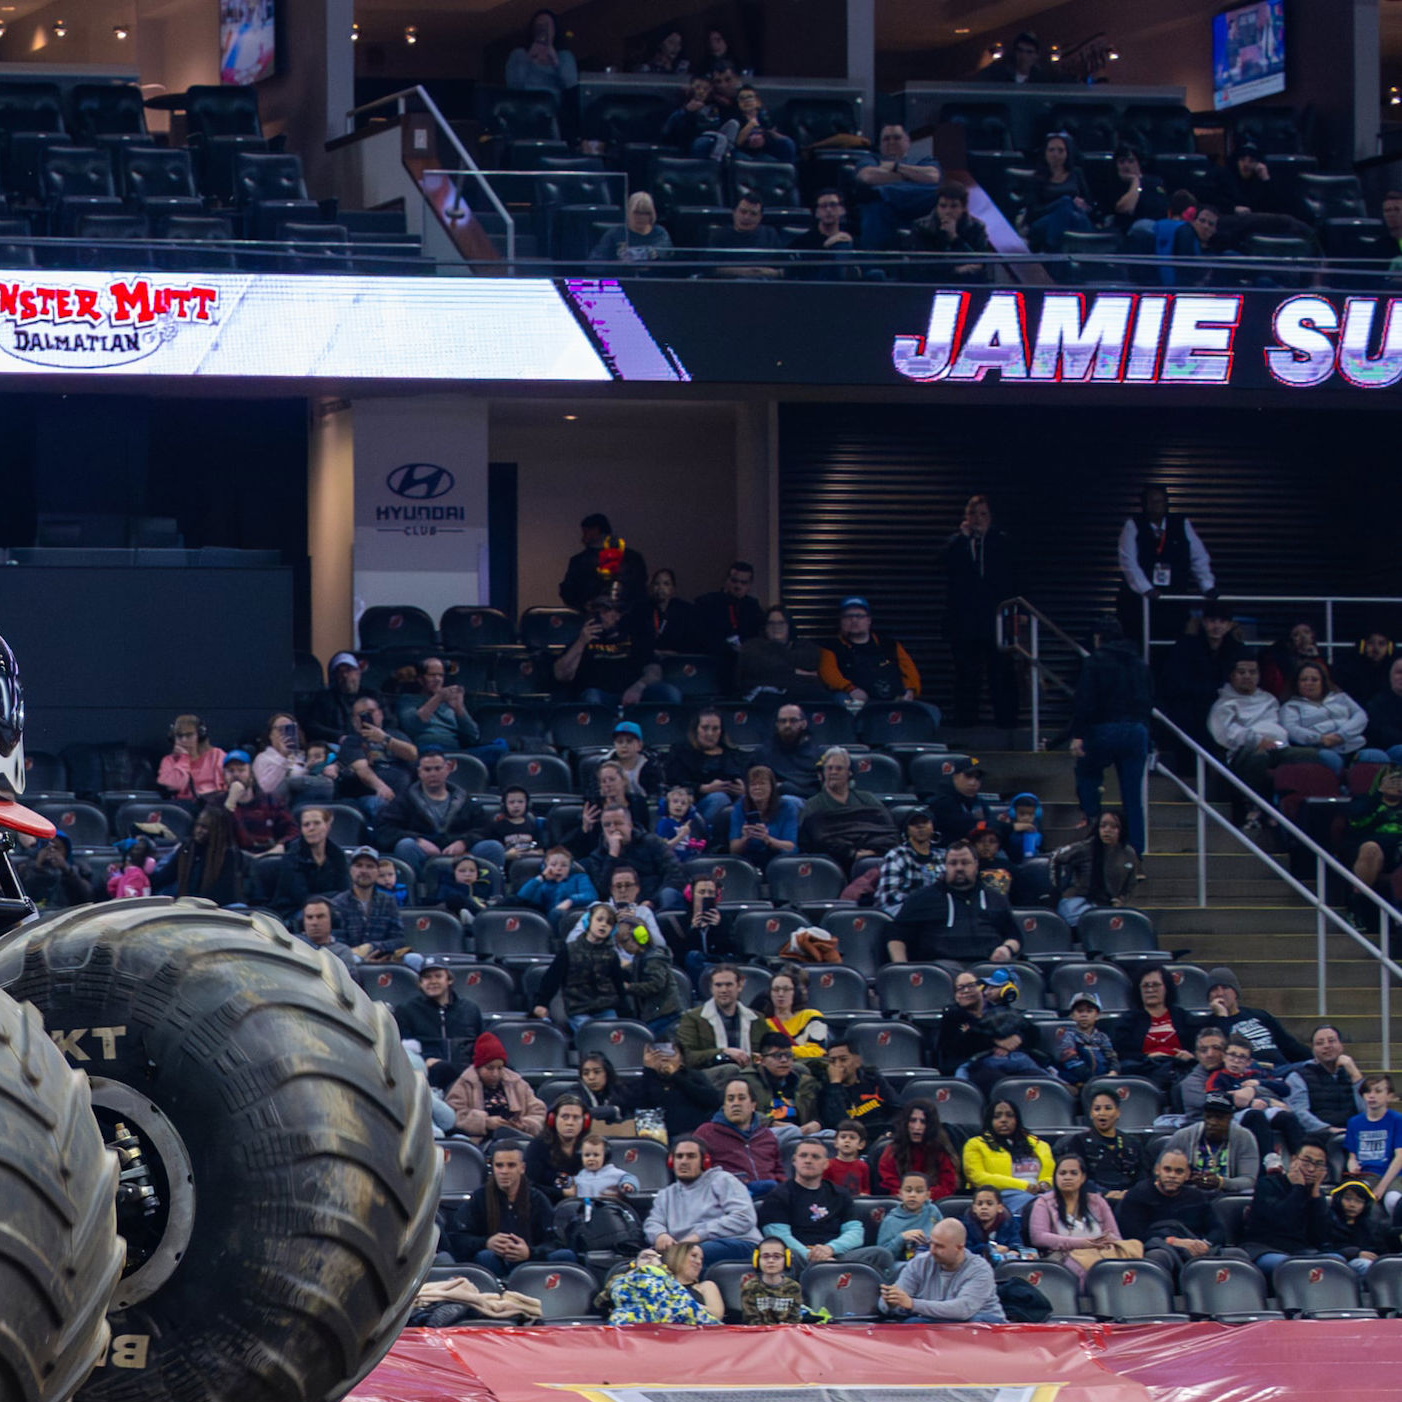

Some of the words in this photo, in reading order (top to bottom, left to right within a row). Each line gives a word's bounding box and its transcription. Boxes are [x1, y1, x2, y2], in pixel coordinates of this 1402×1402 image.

[109, 281, 217, 323] MUTT
[13, 330, 141, 352] DALMATIAN
[892, 290, 1243, 383] JAMIE
[376, 505, 465, 521] HYUNDAI
[404, 526, 437, 536] CLUB
